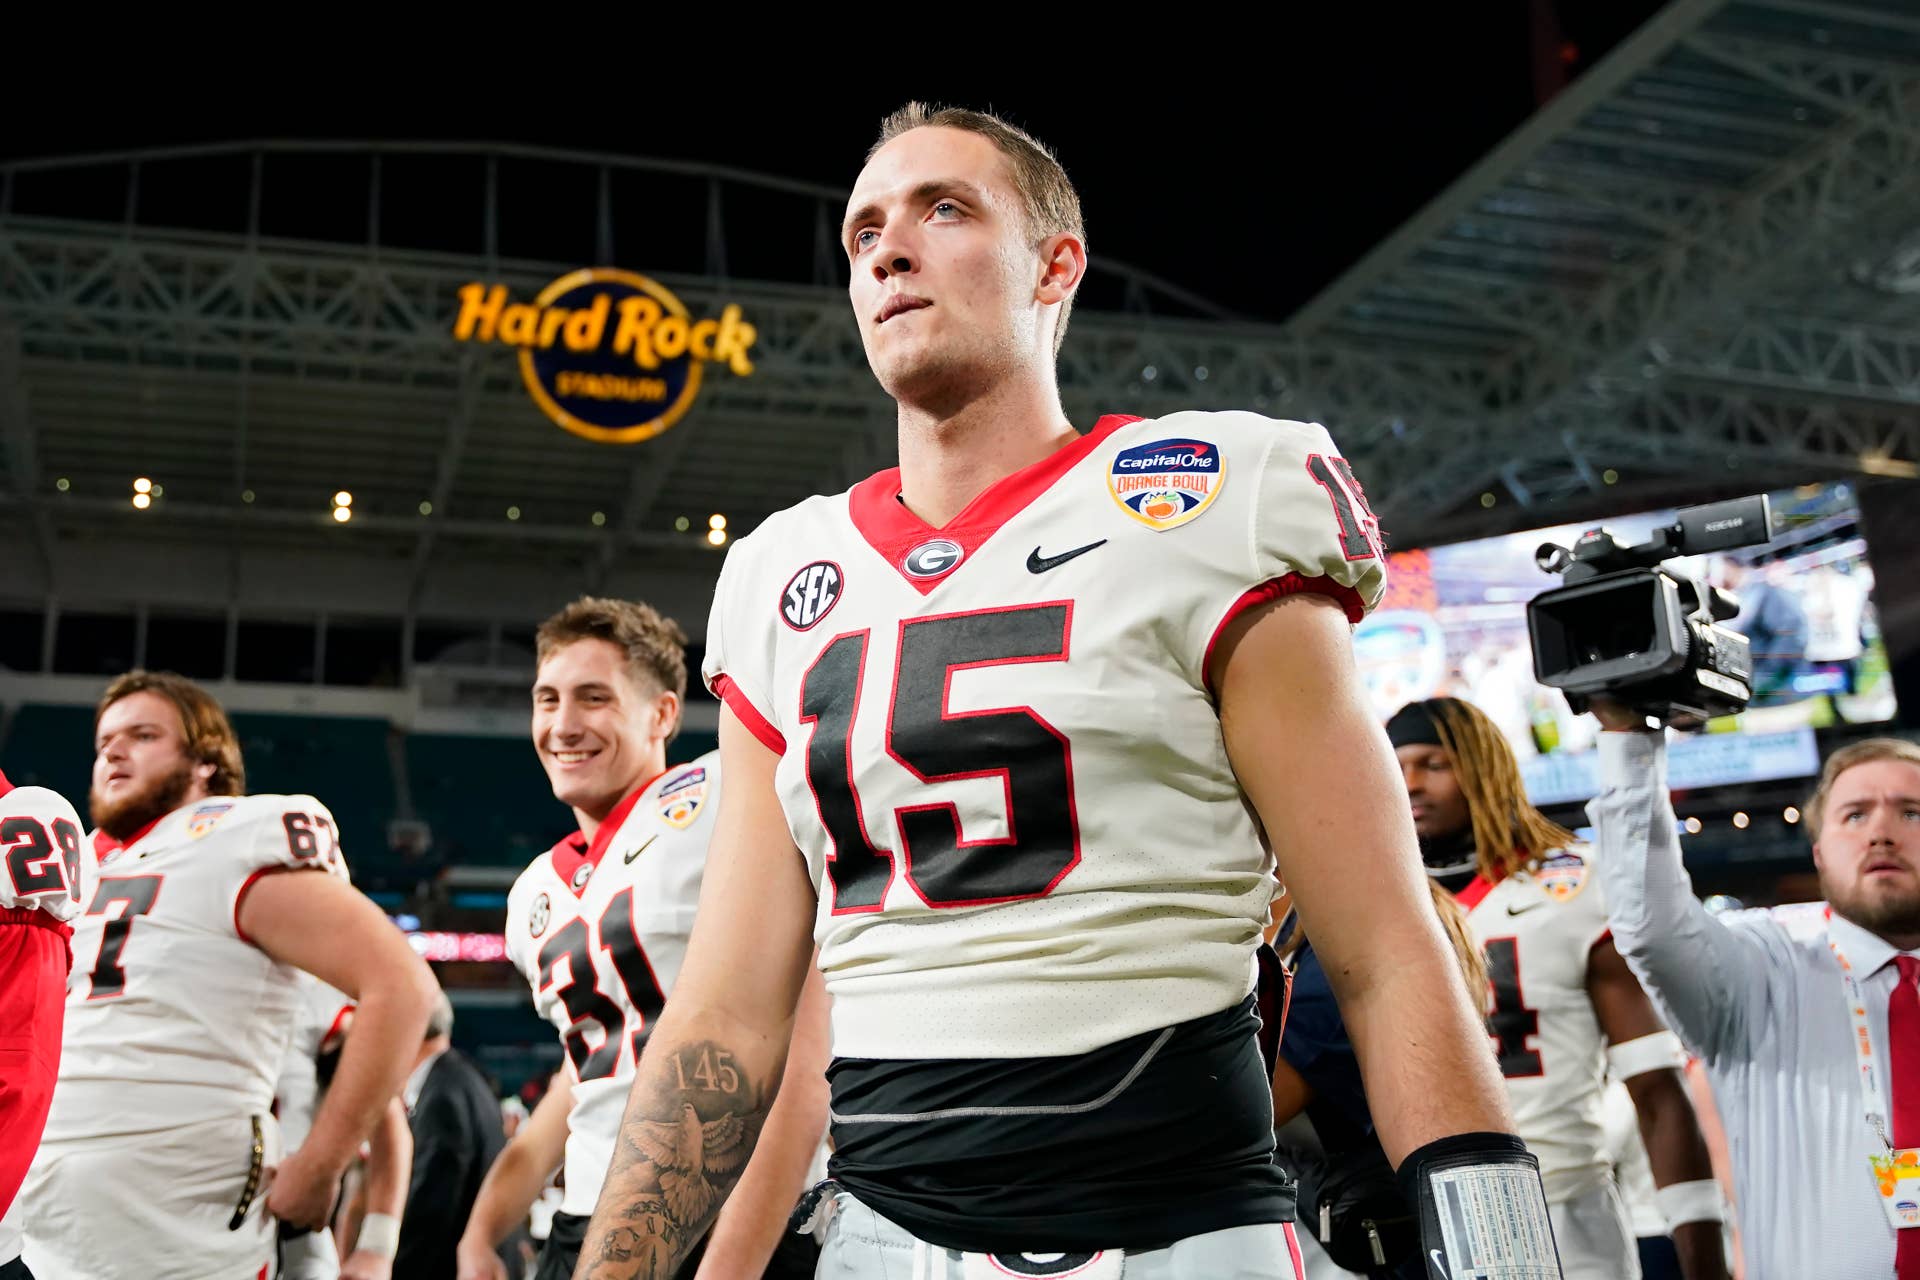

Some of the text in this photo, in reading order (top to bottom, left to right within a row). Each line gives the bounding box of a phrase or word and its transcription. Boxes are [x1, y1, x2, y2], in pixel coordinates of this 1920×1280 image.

[454, 283, 757, 376] Hard Rock
[1117, 475, 1209, 494] ORANGE BOWL
[784, 564, 839, 626] SEC
[799, 599, 1082, 916] 15
[0, 816, 81, 903] 28
[538, 886, 667, 1083] 31
[673, 1048, 739, 1093] 145
